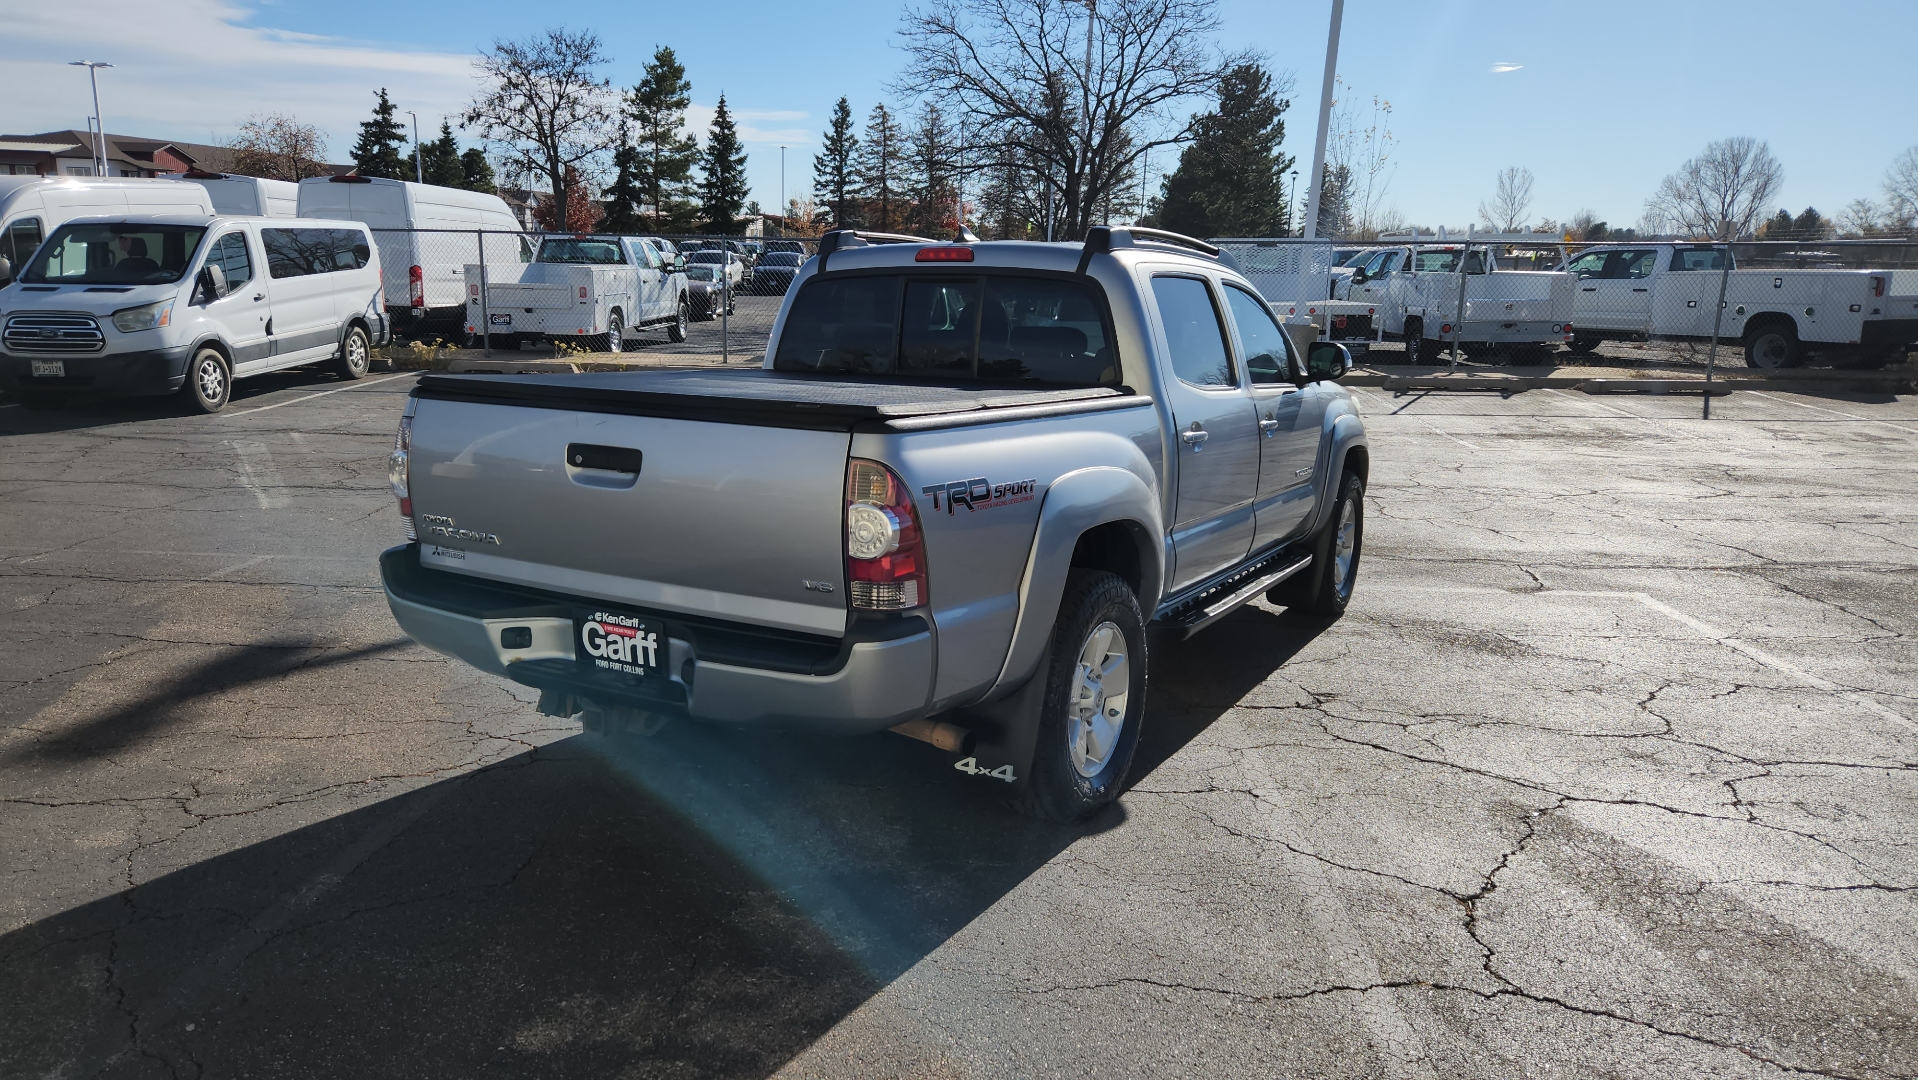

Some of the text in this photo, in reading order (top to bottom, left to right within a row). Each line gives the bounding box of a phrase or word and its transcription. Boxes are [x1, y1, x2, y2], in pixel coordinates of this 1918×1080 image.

[922, 477, 1036, 516] TRD SPORT
[977, 502, 992, 511] TOYOTA
[422, 514, 454, 526] TOYOTA
[423, 524, 500, 545] TACOMA
[441, 551, 465, 560] MITSUBISHI
[802, 580, 833, 593] V6
[603, 612, 639, 628] Ken Garff
[582, 621, 658, 667] Garff
[595, 659, 644, 676] FORD FORT COLLINS
[954, 757, 1018, 783] 4x4
